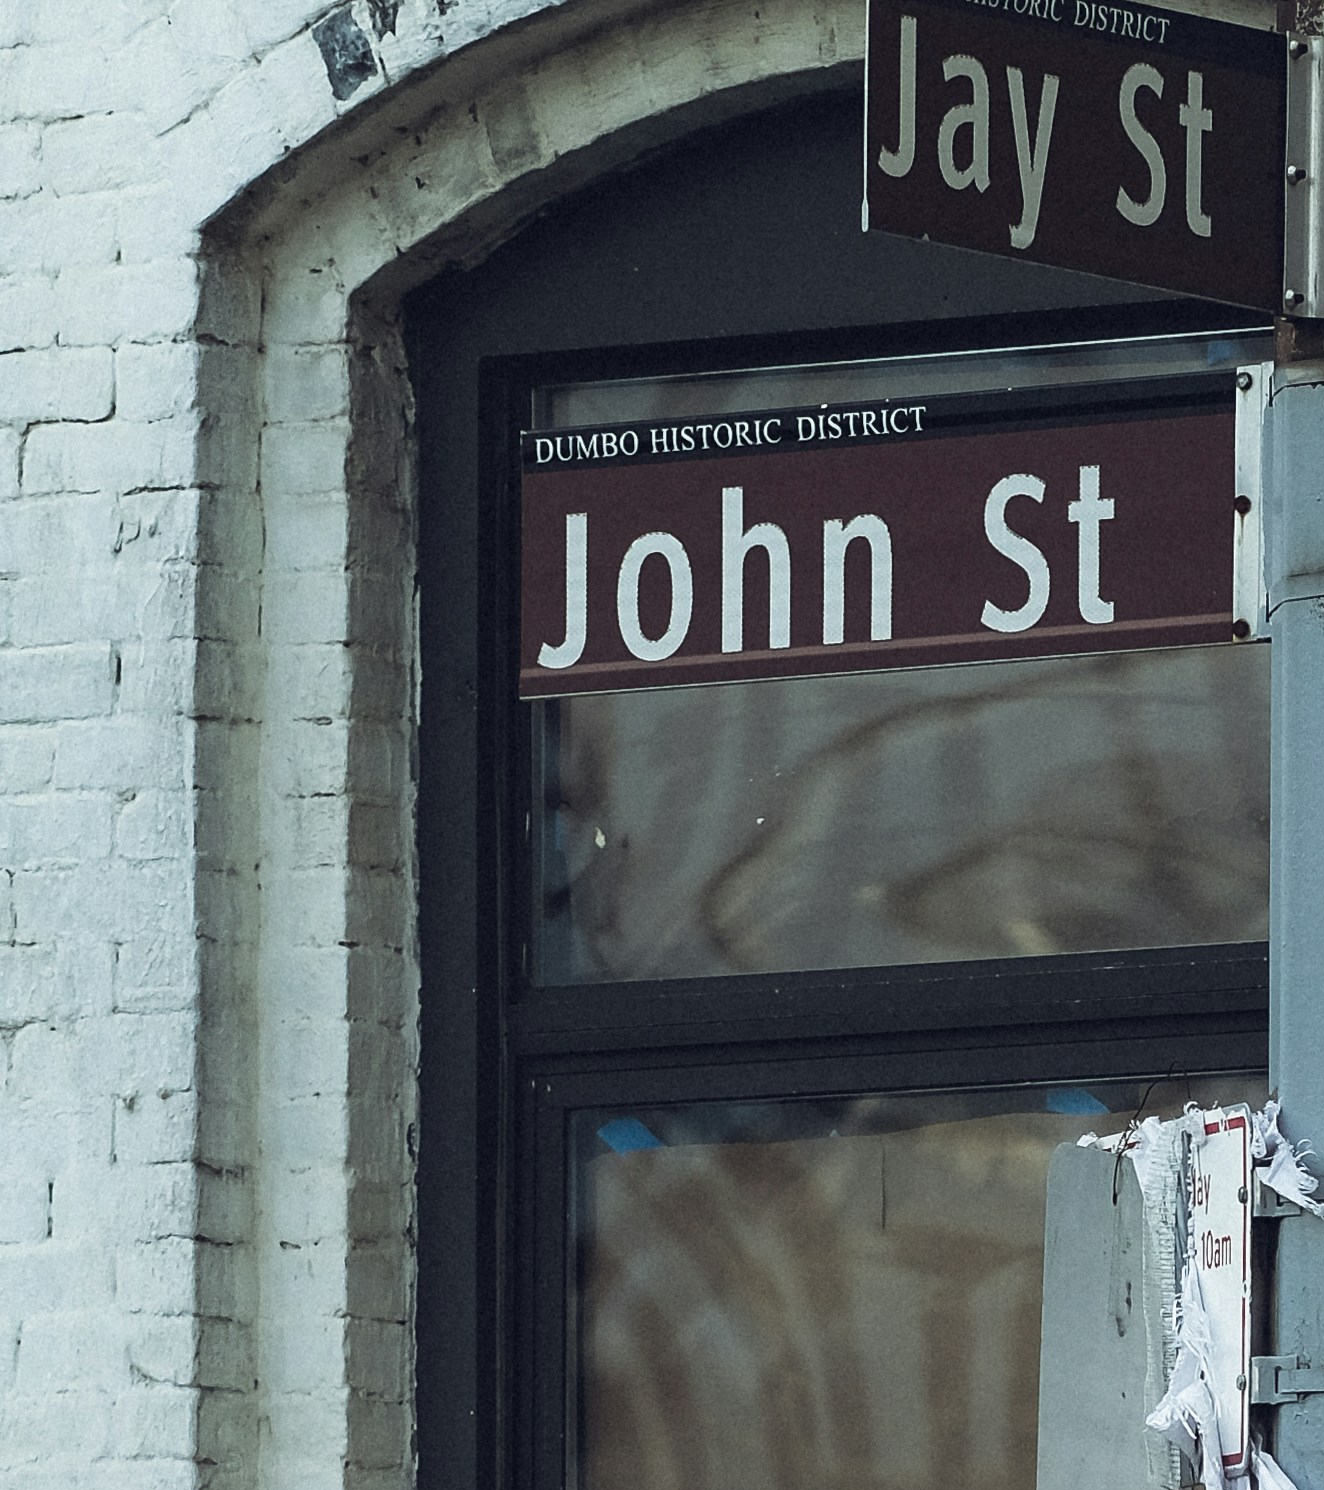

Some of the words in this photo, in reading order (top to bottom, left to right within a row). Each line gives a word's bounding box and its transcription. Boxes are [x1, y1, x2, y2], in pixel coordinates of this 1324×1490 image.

[1074, 0, 1170, 43] DISTRICT
[878, 15, 1060, 249] Jay
[1116, 62, 1213, 237] St
[535, 430, 639, 464] DUMBO
[650, 419, 781, 454] HISTORIC
[797, 406, 927, 442] DISTRICT
[536, 486, 893, 670] John
[979, 465, 1115, 634] St
[1201, 1230, 1232, 1271] 10am
